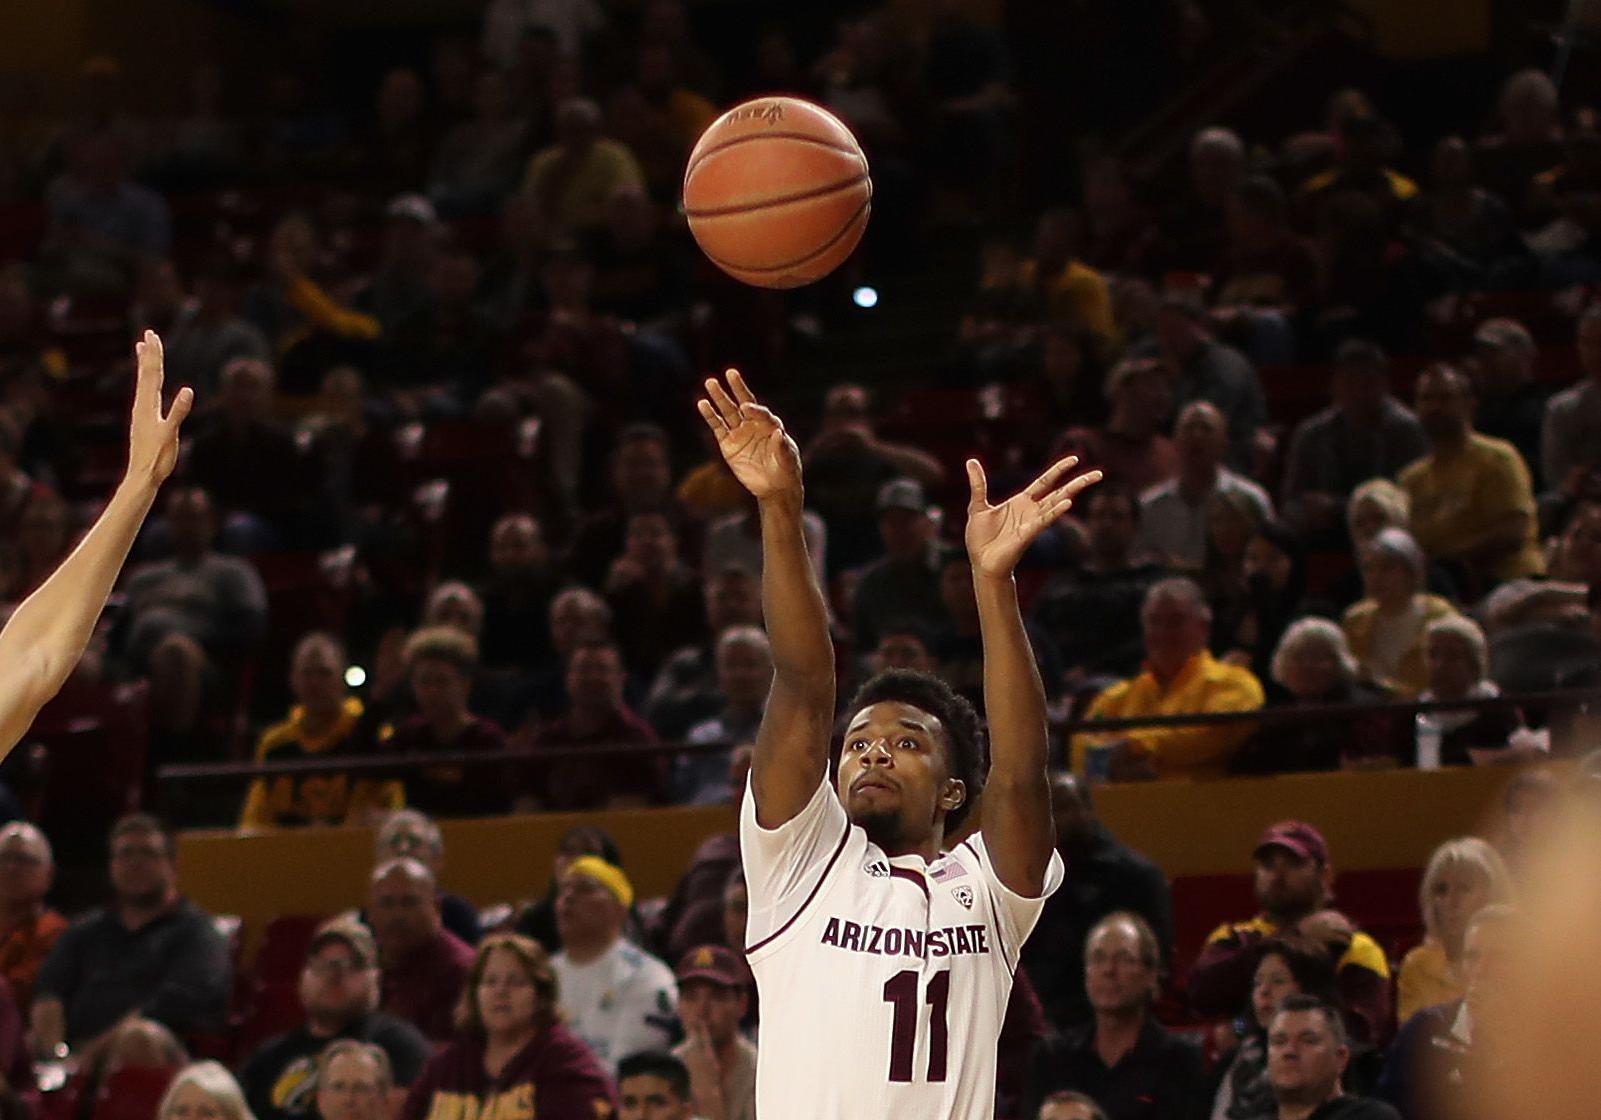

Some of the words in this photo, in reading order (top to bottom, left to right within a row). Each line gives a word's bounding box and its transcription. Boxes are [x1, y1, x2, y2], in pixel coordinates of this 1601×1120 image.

[821, 917, 929, 959] ARIZON
[926, 924, 990, 957] STATE
[883, 969, 951, 1083] 11
